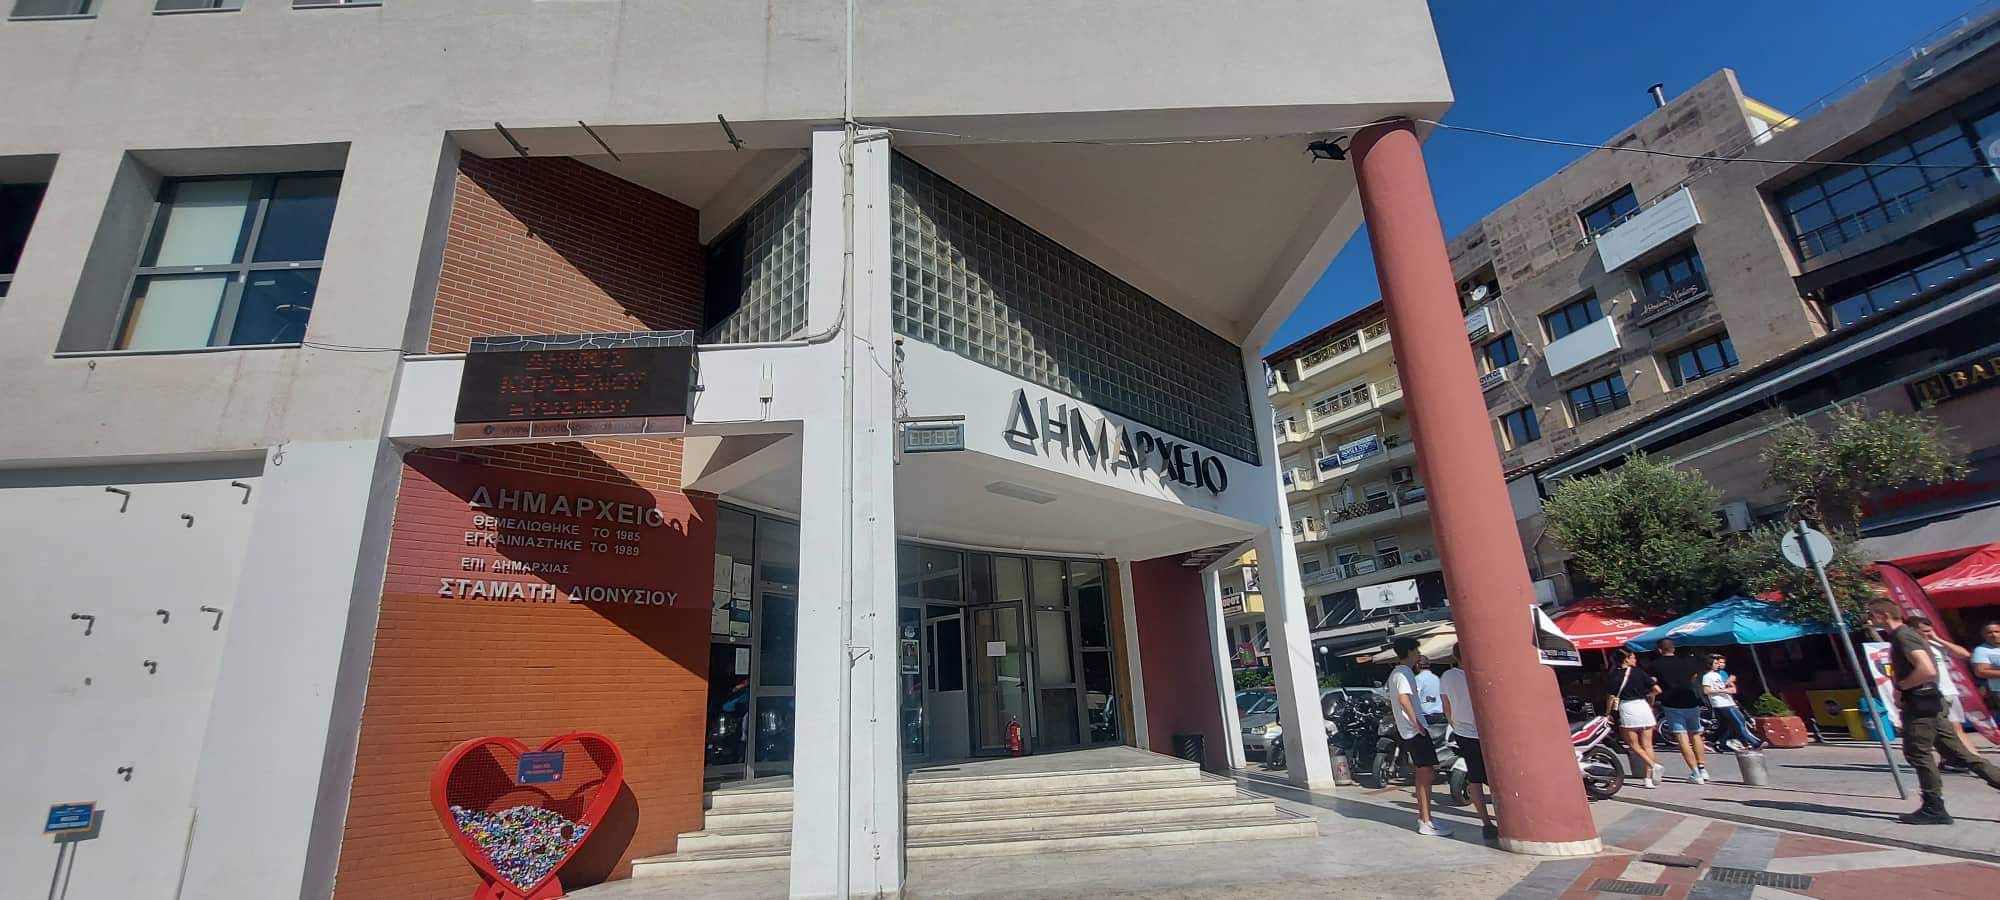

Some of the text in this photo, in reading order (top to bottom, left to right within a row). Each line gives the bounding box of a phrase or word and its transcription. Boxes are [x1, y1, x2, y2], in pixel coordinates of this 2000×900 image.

[1003, 387, 1228, 497] ΔΗΜΑΡΧΕΙΟ
[469, 486, 664, 528] ΔΗΜΑΡΧΕΙΟ
[472, 515, 641, 541] ΘΕΜΕΛΙΩΘΗΚΕ ΤΟ 1985
[464, 531, 640, 556] ΕΓΚΑΙΝΙΑΣΤΗΚΕ ΤΟ 1989
[461, 557, 569, 574] ΕΠΙ ΔΗΜΑΡΧΙΑΣ
[437, 577, 679, 607] ΣΤΑΜΑΤΗ ΔΙΟΝΥΣΙΟΥ
